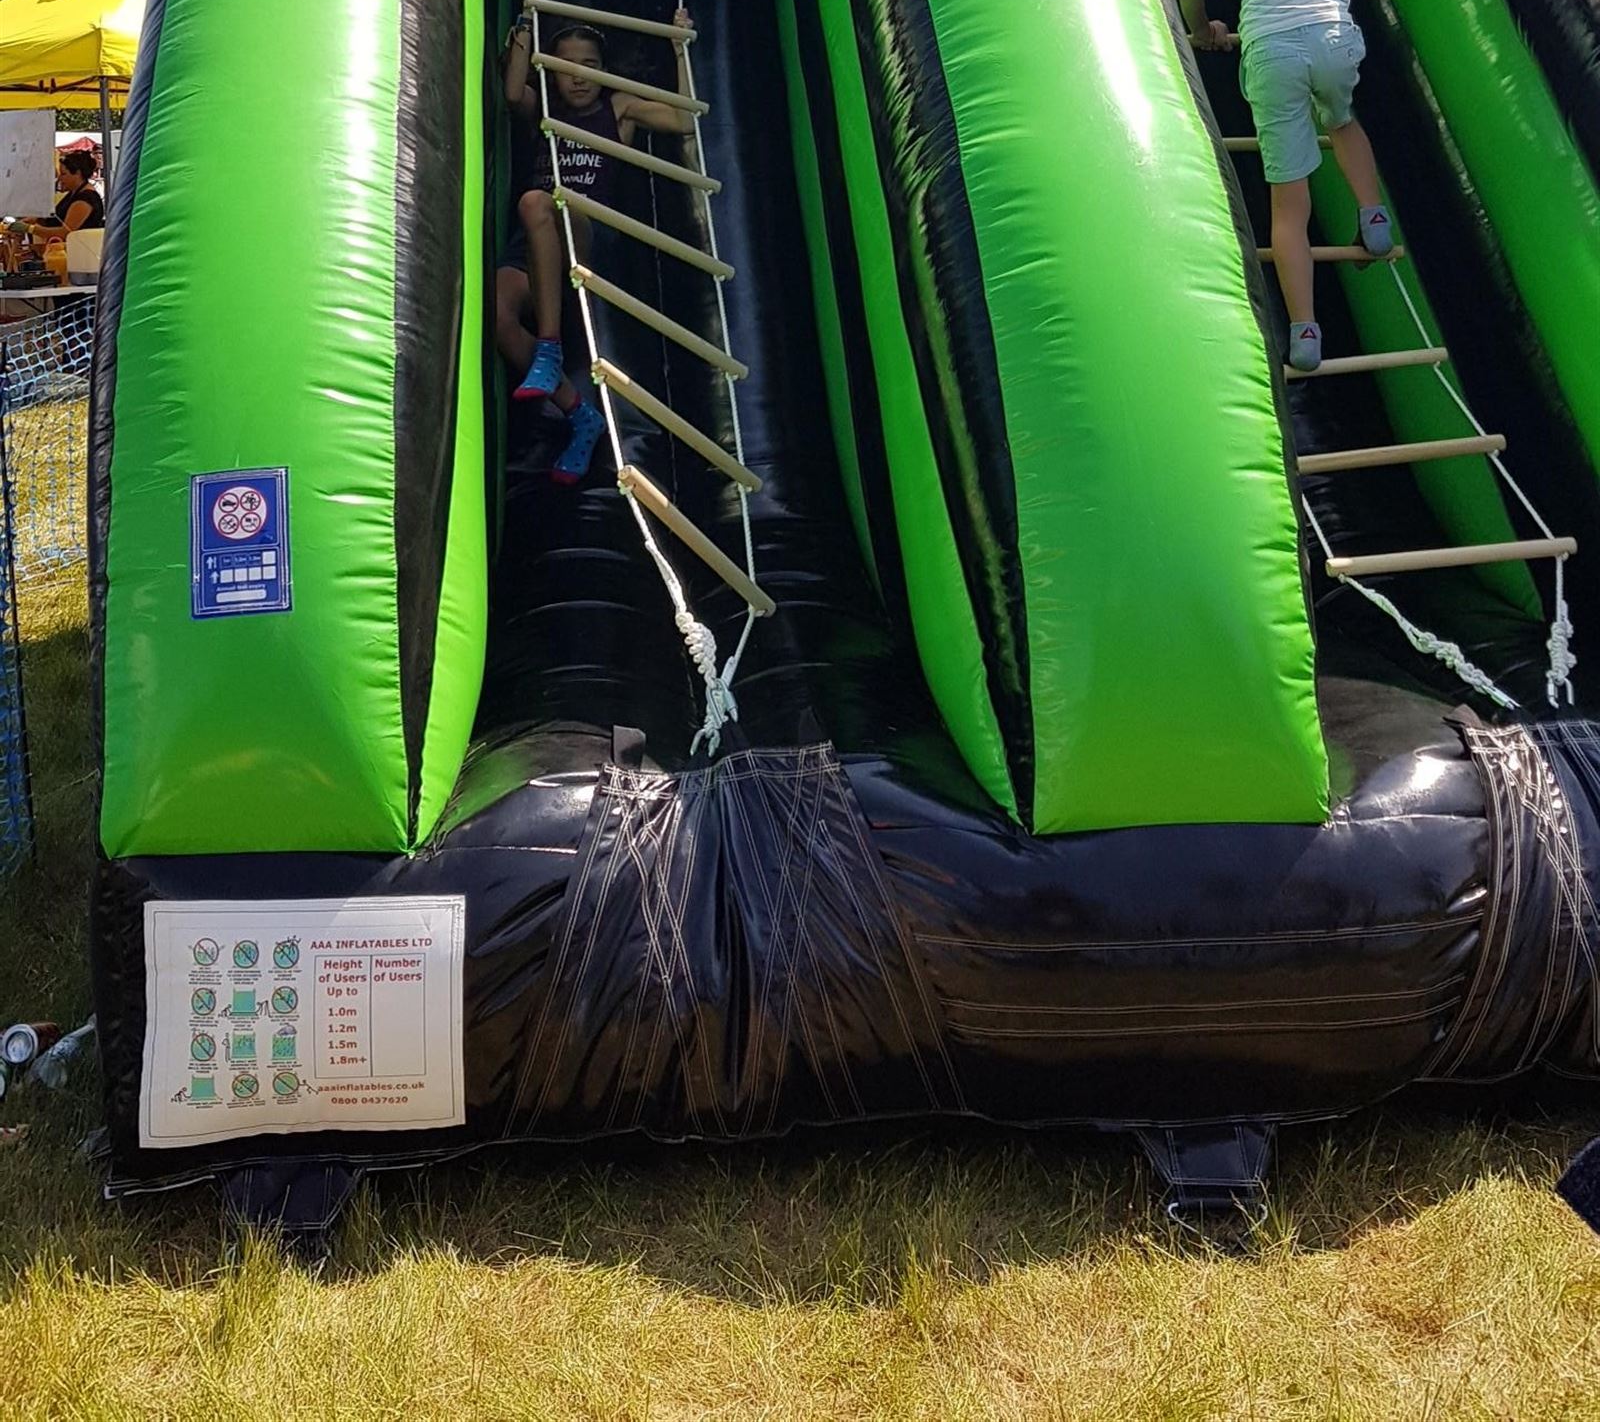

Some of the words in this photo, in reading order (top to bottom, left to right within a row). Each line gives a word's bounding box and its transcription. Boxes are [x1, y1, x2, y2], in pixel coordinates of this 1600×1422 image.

[310, 941, 332, 950] AAA
[336, 938, 409, 949] INFLATABLES
[412, 938, 433, 947] LTD
[323, 959, 363, 971] Height
[375, 958, 422, 968] Number
[318, 973, 331, 983] of
[334, 973, 367, 983] Users
[373, 972, 387, 982] of
[389, 972, 422, 982] Users
[327, 987, 343, 998] Up
[346, 987, 358, 996] to
[328, 1007, 357, 1017] 1.0m
[328, 1024, 357, 1033] 1.2m
[328, 1040, 358, 1049] 1.5m
[329, 1056, 367, 1065] 1.8m+
[331, 1096, 358, 1104] 0800
